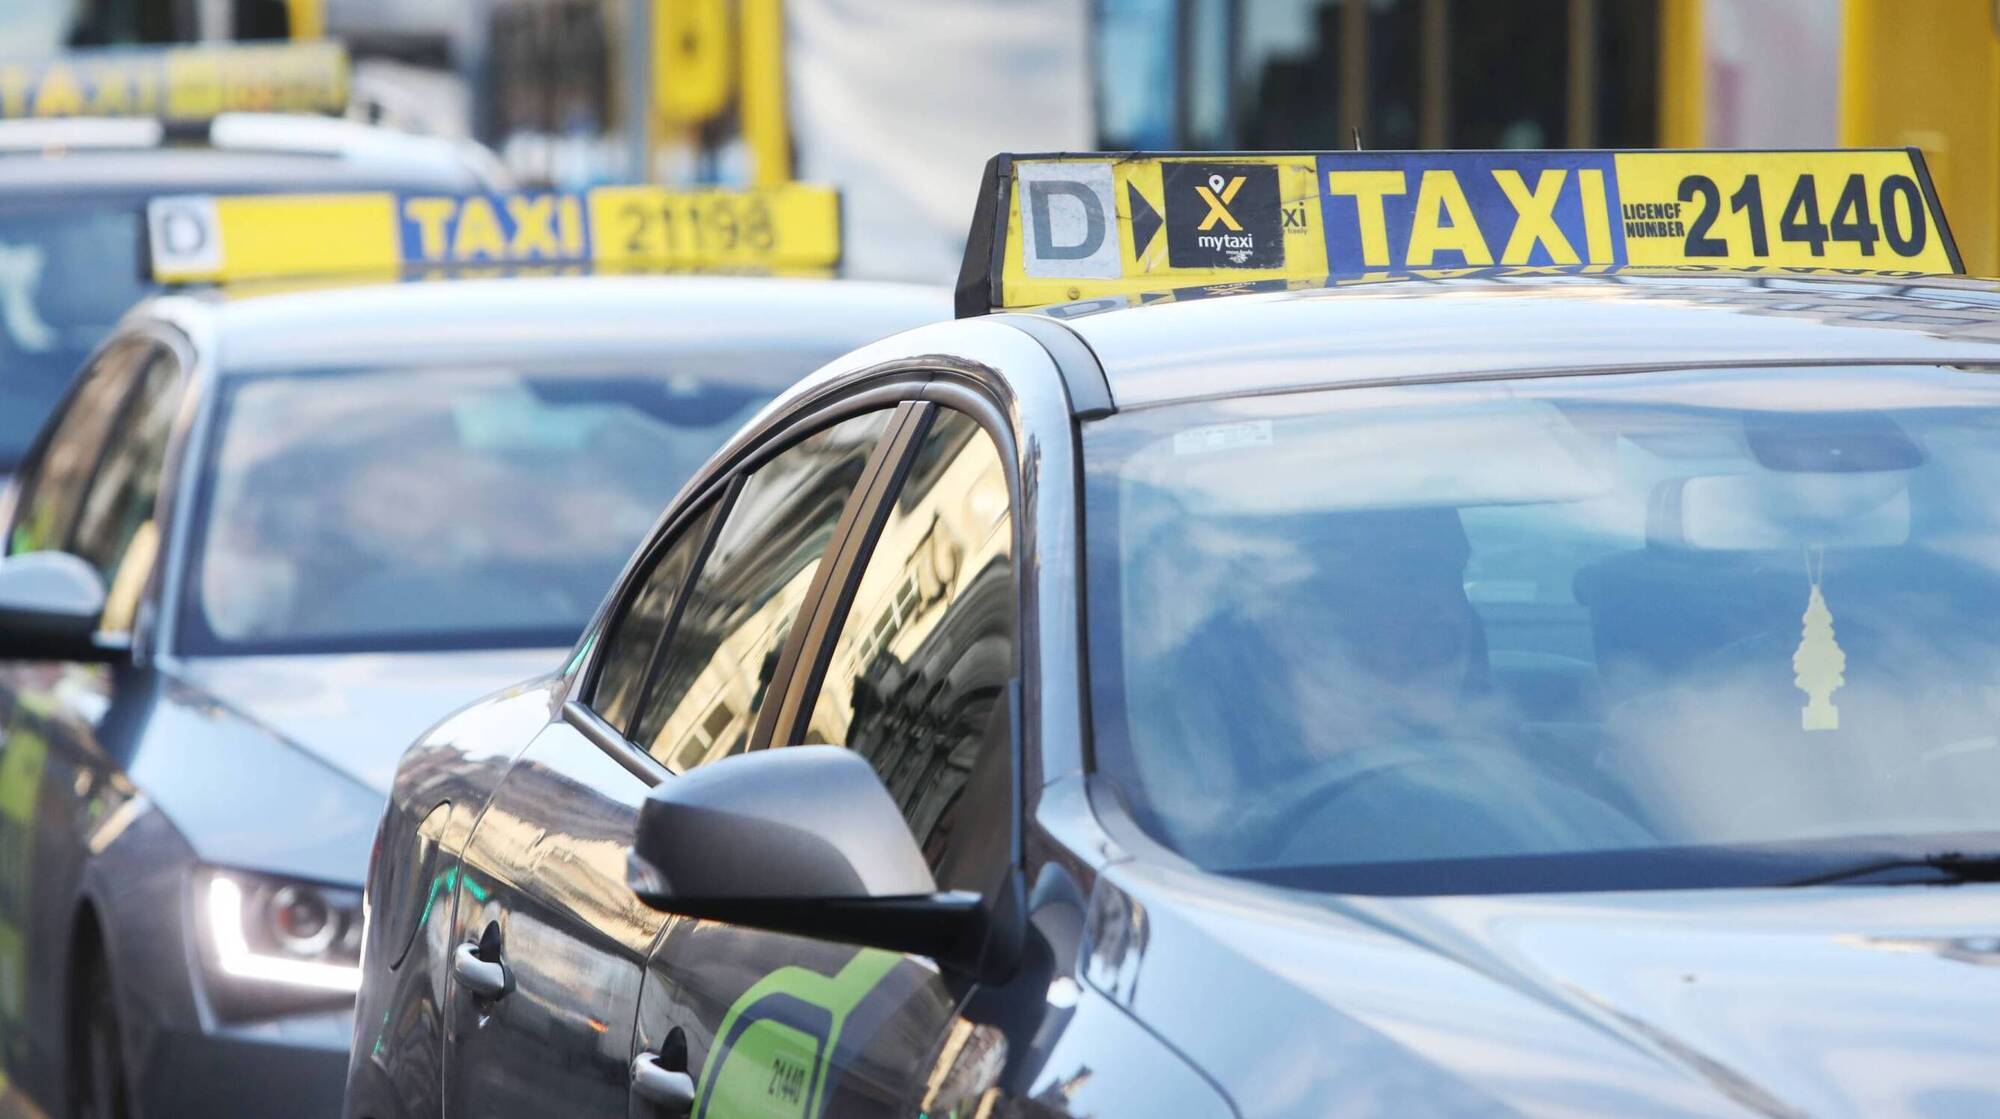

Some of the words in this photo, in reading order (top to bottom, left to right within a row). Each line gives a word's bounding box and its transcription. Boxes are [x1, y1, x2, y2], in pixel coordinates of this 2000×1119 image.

[161, 207, 206, 257] D
[404, 196, 585, 259] TAXI
[617, 199, 775, 254] 21198
[1029, 180, 1106, 260] D
[1198, 233, 1253, 252] mytaxi
[1329, 169, 1614, 266] TAXI
[1625, 221, 1685, 238] NUMBER
[1677, 173, 1928, 260] 21440
